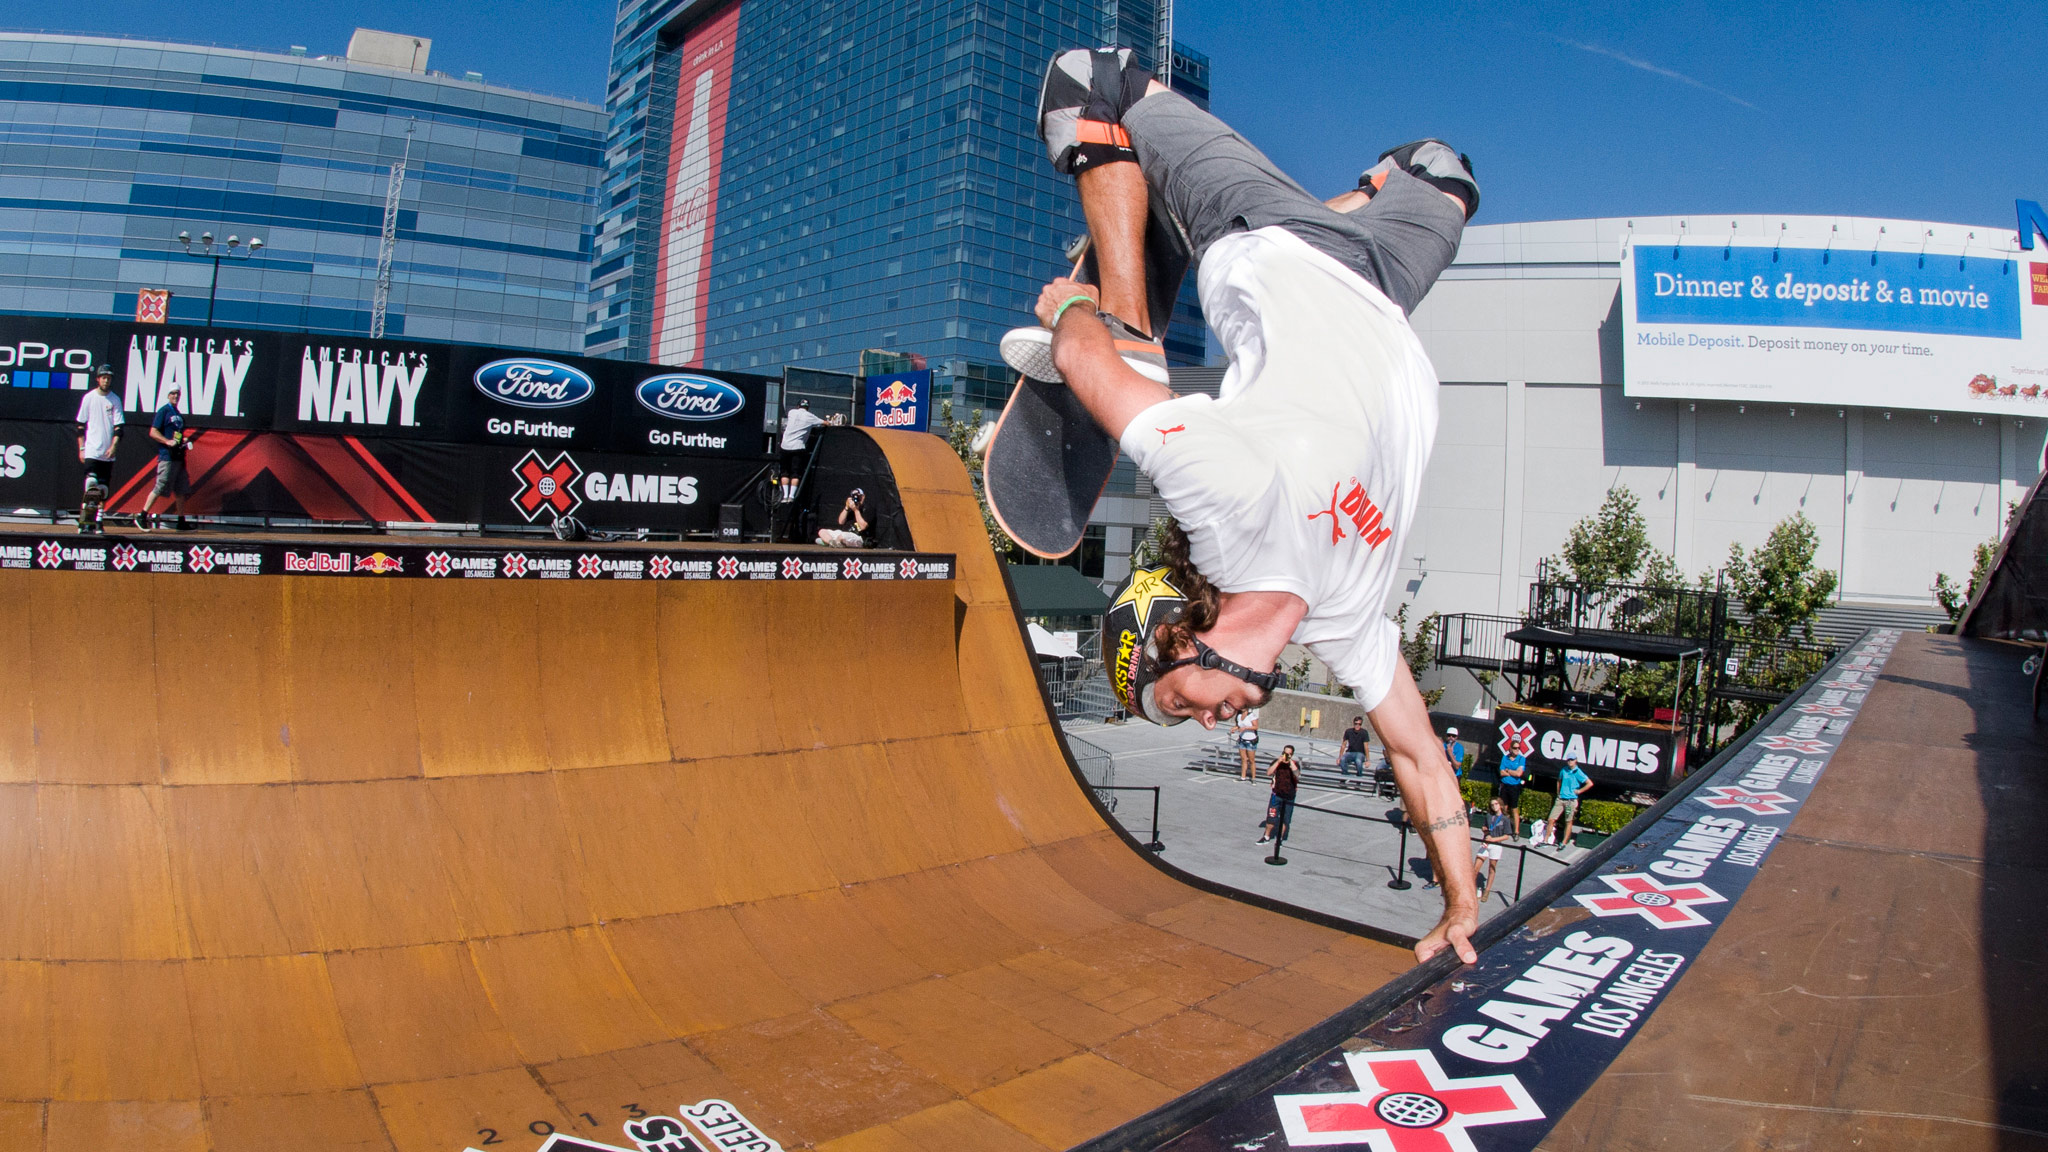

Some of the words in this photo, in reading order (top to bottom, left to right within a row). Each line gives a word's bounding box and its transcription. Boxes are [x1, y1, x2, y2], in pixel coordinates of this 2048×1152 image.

[1654, 273, 1744, 297] Dinner
[1750, 275, 1769, 299] &
[1775, 274, 1870, 306] deposit
[1875, 280, 1893, 303] &
[1900, 287, 1914, 304] a
[1918, 285, 1989, 309] movie
[1637, 332, 1685, 347] Mobile
[1688, 334, 1745, 351] Deposit.
[1748, 335, 1801, 352] Deposit
[1803, 340, 1848, 354] money
[1851, 342, 1868, 353] on
[1869, 344, 1900, 357] your
[1902, 343, 1934, 357] time.
[124, 349, 254, 417] NAVY
[298, 359, 428, 427] NAVY
[498, 364, 571, 400] Ford
[657, 379, 723, 413] Ford
[487, 418, 512, 434] Go
[514, 419, 575, 438] Further
[648, 429, 671, 445] Go
[672, 431, 727, 449] Further
[585, 471, 699, 505] GAMES
[61, 547, 107, 562] GAMES
[137, 550, 183, 564] GAMES
[214, 552, 262, 566] GAMES
[451, 557, 497, 570] GAMES
[527, 559, 572, 571] GAMES
[601, 560, 644, 572] GAMES
[672, 561, 713, 573] GAMES
[739, 561, 777, 573] GAMES
[802, 562, 838, 573] GAMES
[862, 563, 896, 573] GAMES
[917, 563, 949, 573] GAMES
[1128, 643, 1142, 680] DRINK
[1540, 730, 1661, 774] GAMES
[1738, 753, 1798, 790] GAMES
[1649, 815, 1745, 878] GAMES
[1735, 824, 1780, 854] ANGELES
[1723, 848, 1764, 867] LOS
[1600, 949, 1685, 1013] ANGELES
[1442, 931, 1634, 1063] GAMES
[1573, 1001, 1640, 1039] LOS
